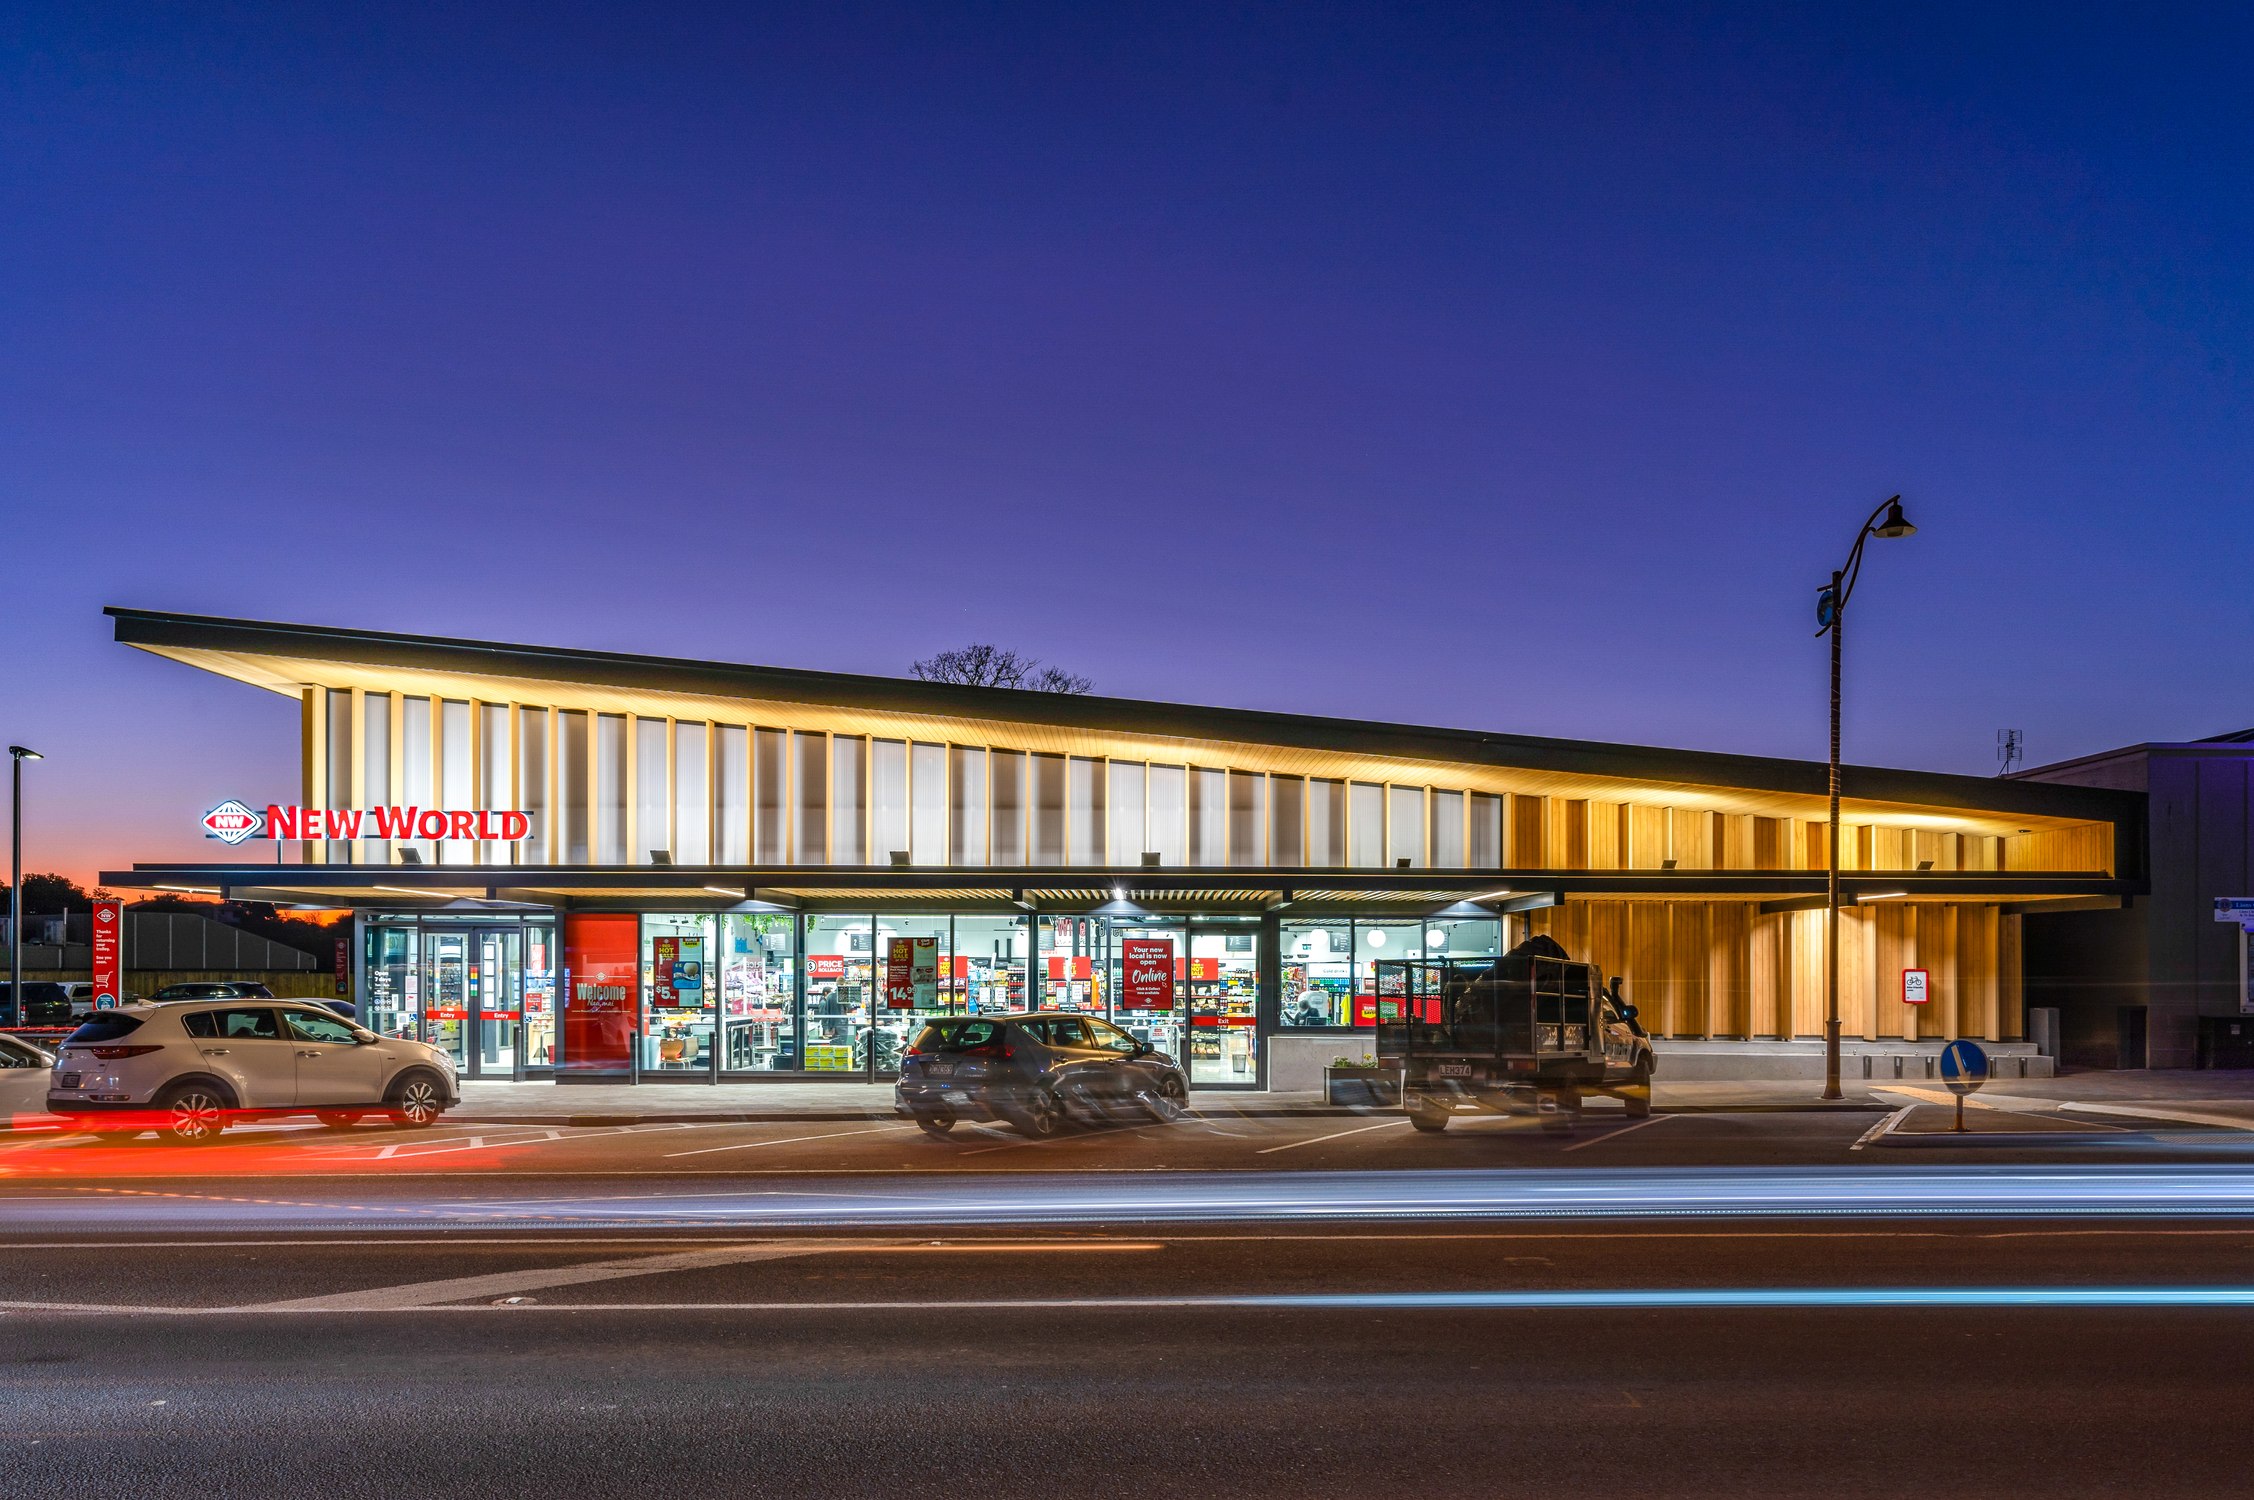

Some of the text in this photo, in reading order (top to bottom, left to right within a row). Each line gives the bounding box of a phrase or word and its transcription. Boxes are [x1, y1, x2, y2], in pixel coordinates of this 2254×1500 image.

[214, 815, 245, 829] NW
[817, 960, 843, 968] PRICE
[1132, 967, 1168, 984] Online
[576, 983, 626, 1001] Welcome
[1440, 1066, 1470, 1075] LEH374
